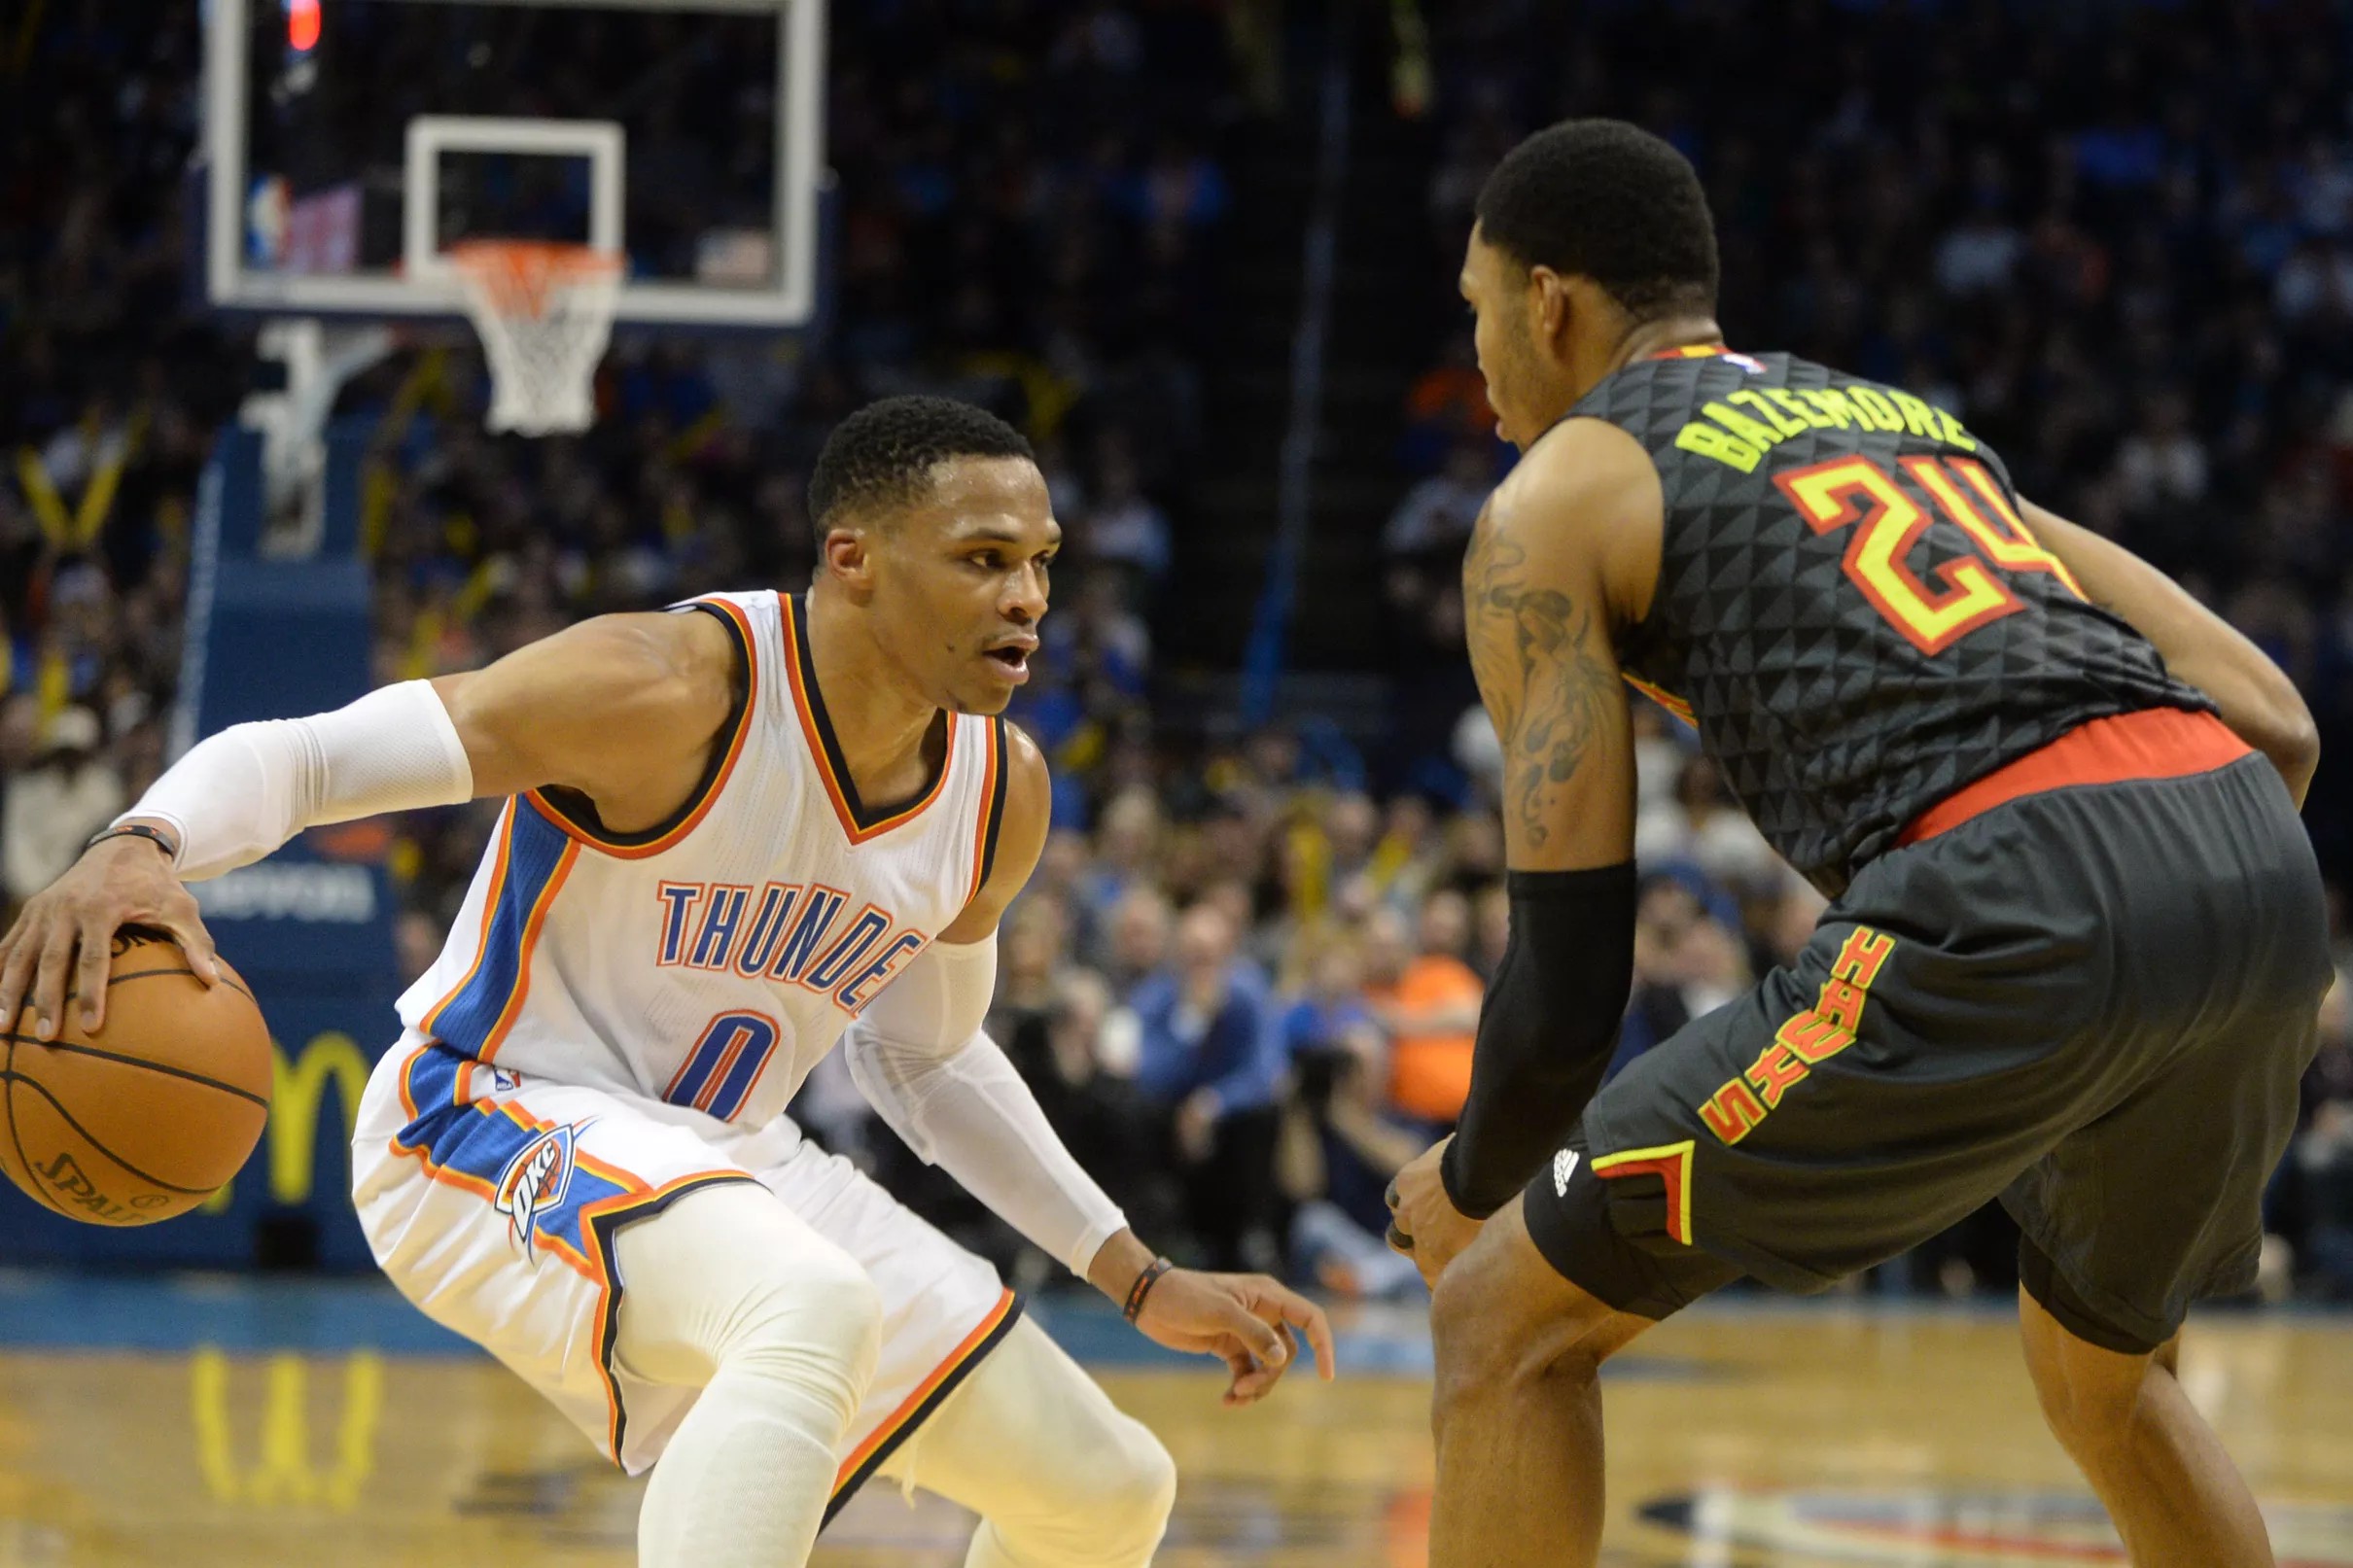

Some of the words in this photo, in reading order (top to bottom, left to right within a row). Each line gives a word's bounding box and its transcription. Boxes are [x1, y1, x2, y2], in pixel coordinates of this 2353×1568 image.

[1675, 385, 1977, 473] BAZEMORE
[1772, 454, 2090, 657] 24
[655, 879, 931, 1020] THUNDE
[661, 1009, 781, 1123] 0
[1697, 925, 1896, 1146] HAWKS
[502, 1138, 556, 1243] OKC
